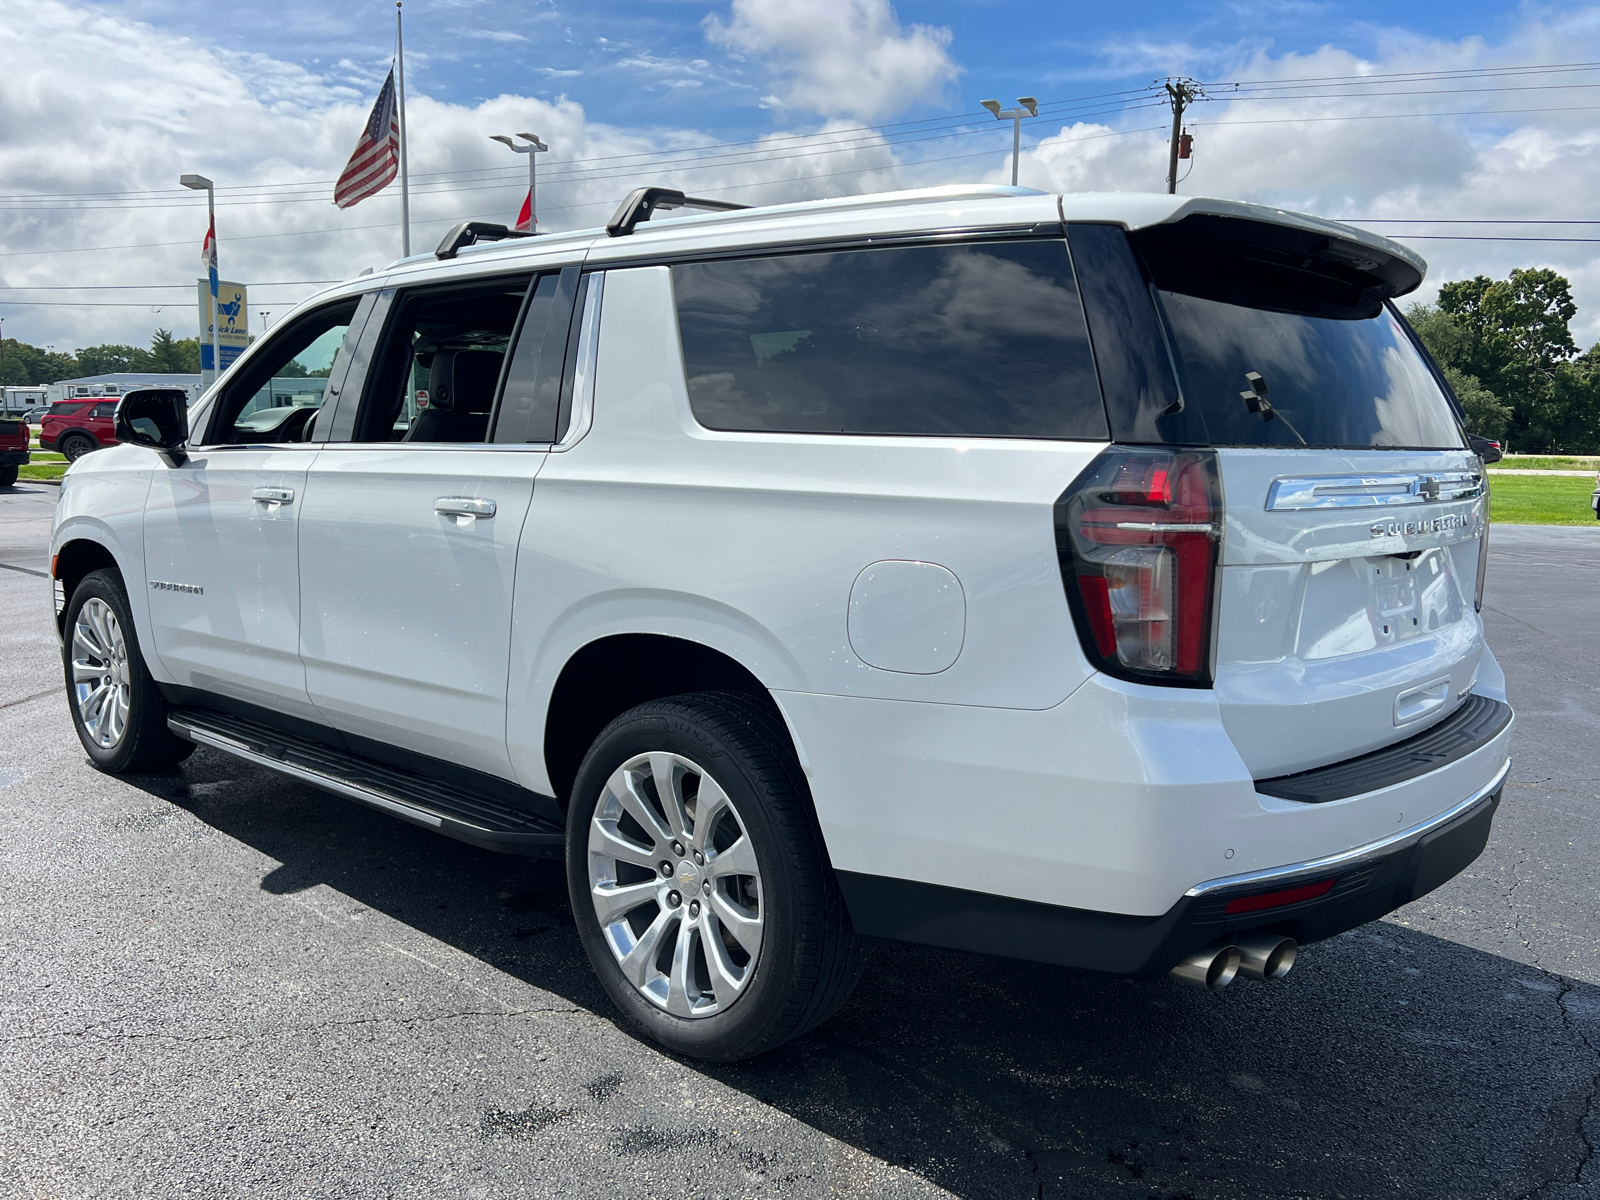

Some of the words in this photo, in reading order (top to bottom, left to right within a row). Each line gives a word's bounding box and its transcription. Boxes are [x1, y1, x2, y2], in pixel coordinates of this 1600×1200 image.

[208, 325, 230, 333] Qick
[230, 327, 246, 335] Lane
[1370, 515, 1468, 539] SUBURBAN
[149, 580, 204, 595] SUBURBAN
